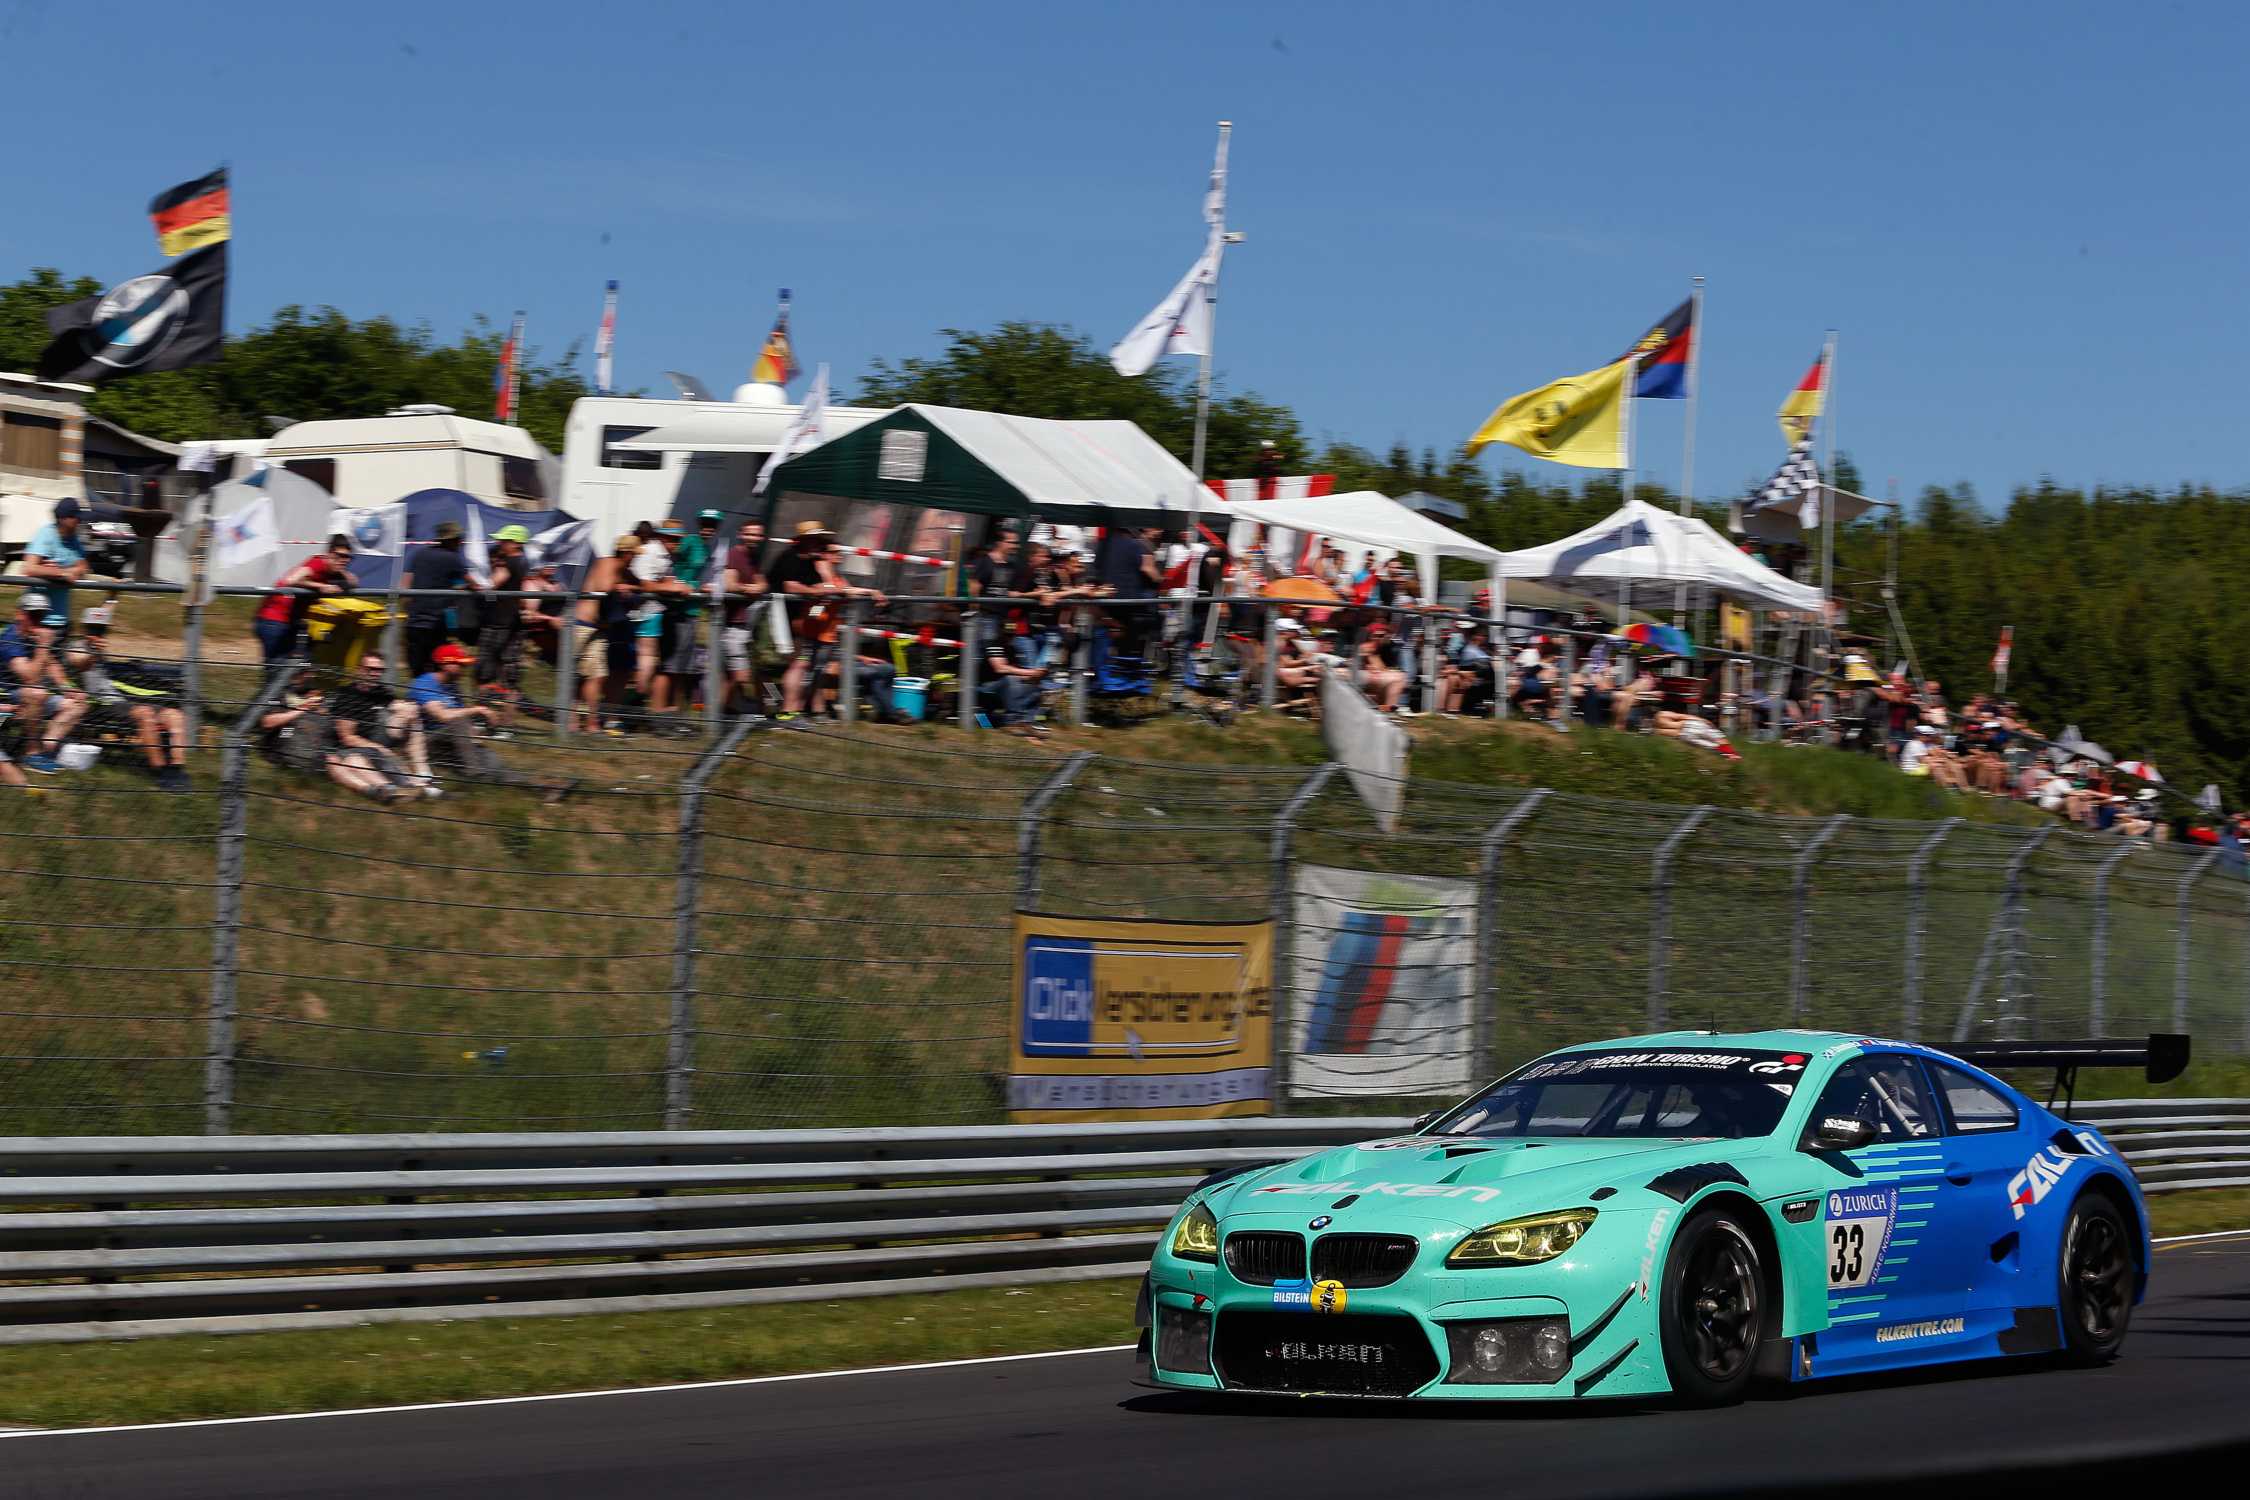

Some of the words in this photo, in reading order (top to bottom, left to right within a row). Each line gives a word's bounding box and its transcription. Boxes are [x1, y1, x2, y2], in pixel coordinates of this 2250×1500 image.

[1597, 1053, 1655, 1066] GRAN
[2007, 1131, 2111, 1221] FALN
[1843, 1193, 1887, 1213] ZURICH
[1830, 1223, 1864, 1283] 33
[1871, 1252, 1885, 1286] ADAC
[1273, 1292, 1310, 1304] BILSTEIN
[1876, 1317, 1965, 1343] FALKENTYRE.COM
